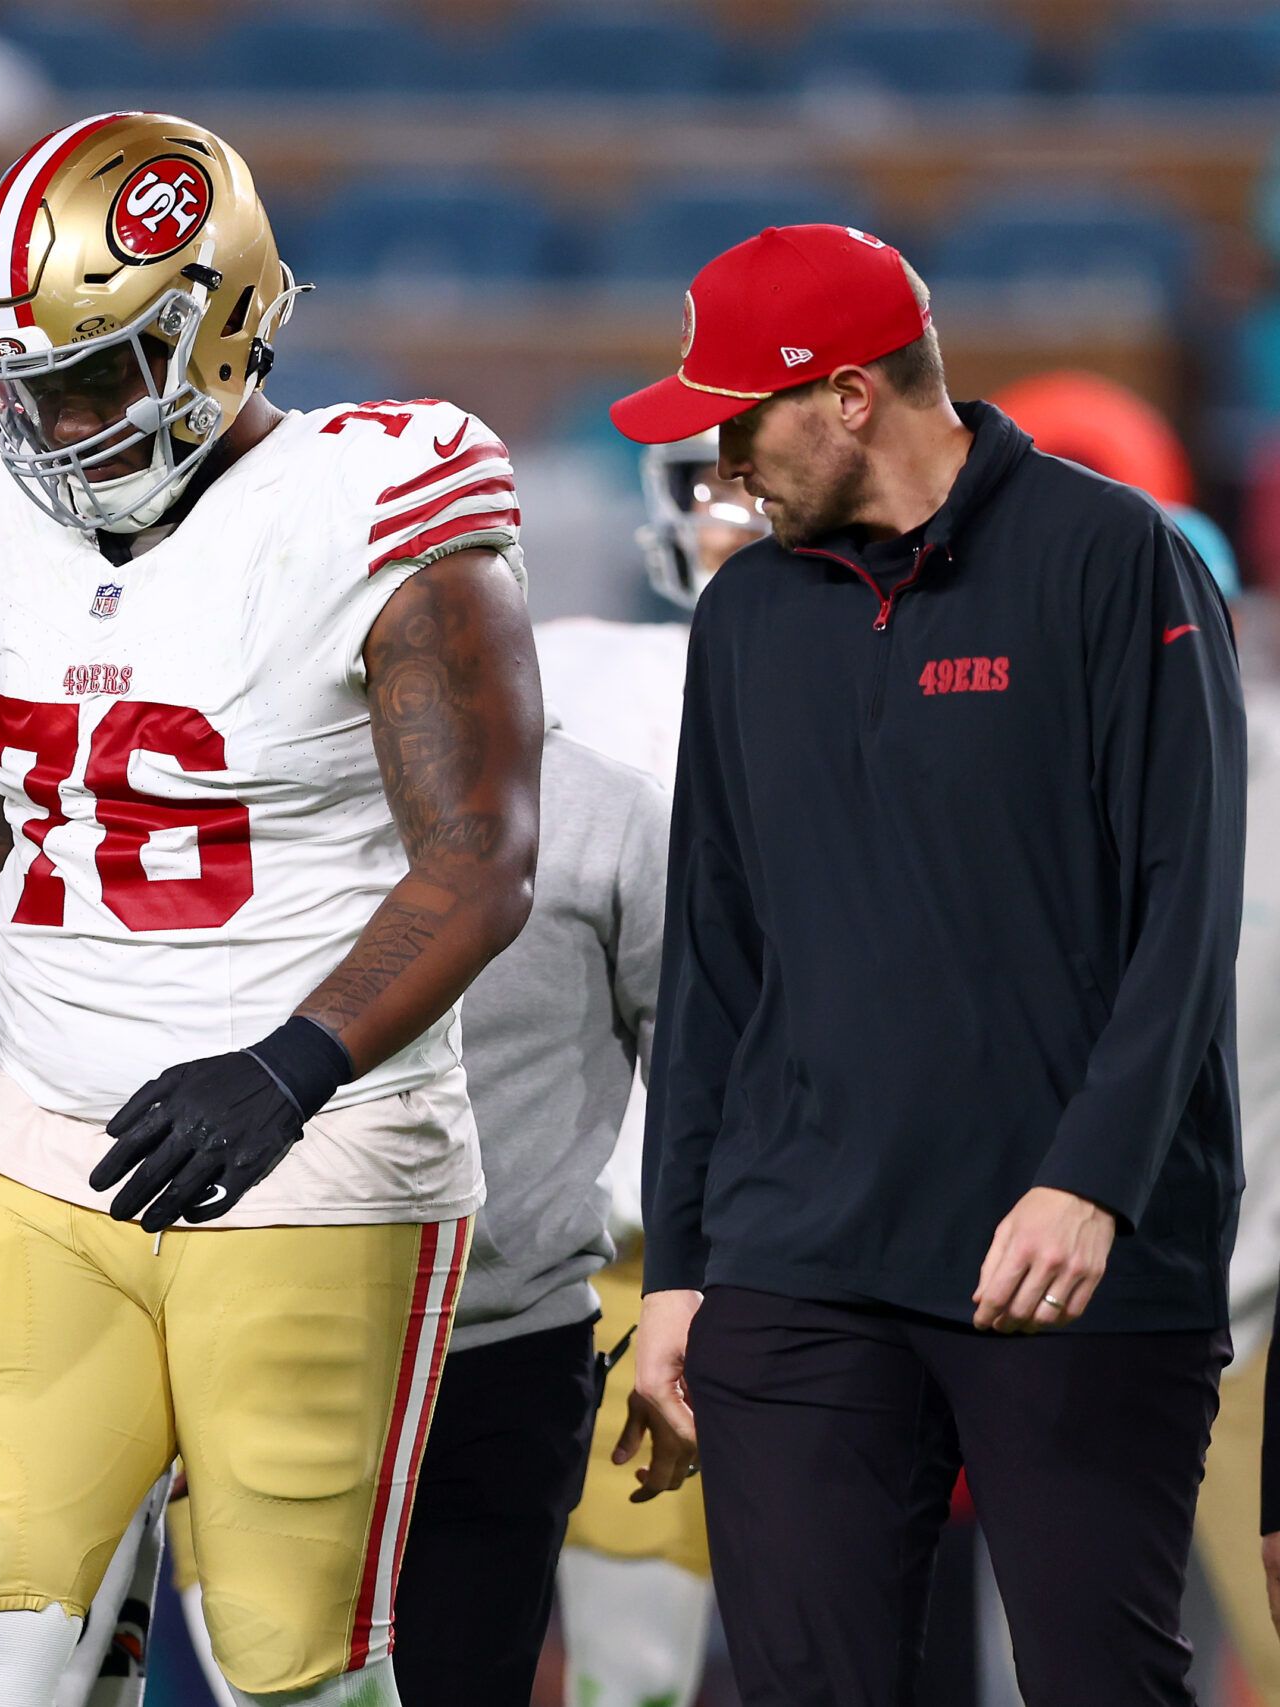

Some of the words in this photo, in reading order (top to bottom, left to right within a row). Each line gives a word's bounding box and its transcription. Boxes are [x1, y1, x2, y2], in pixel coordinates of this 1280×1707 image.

[126, 171, 199, 239] SF
[94, 598, 118, 614] NFL
[63, 664, 133, 696] 49ERS
[919, 656, 1009, 695] 49ERS
